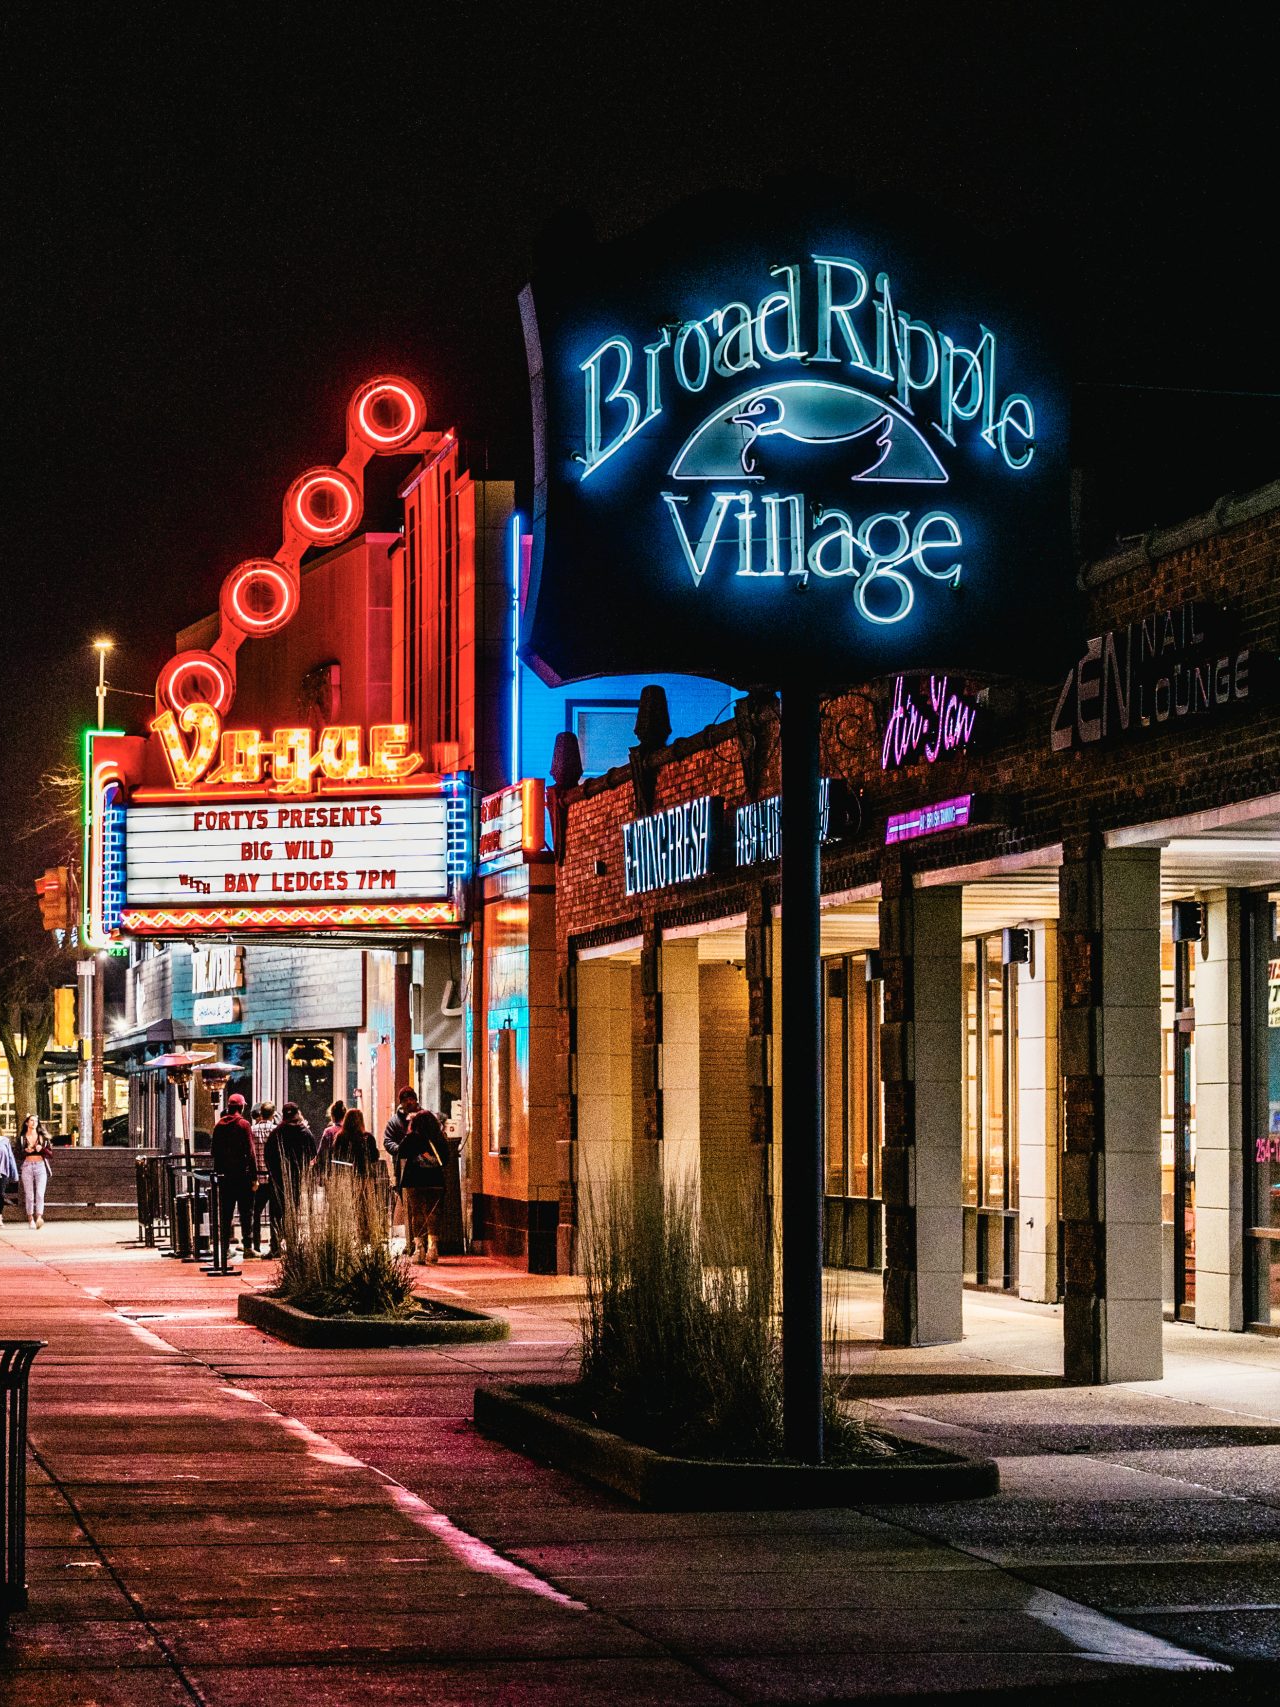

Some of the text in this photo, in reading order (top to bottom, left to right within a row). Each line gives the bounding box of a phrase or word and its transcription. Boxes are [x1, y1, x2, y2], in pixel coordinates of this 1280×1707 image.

[577, 254, 1036, 481] Broad Ripple
[660, 490, 963, 625] Village
[1141, 601, 1204, 662] NAIL
[1140, 650, 1249, 727] LOUNGE
[150, 702, 424, 794] Vogue
[241, 839, 334, 861] BIG WILD
[278, 805, 382, 829] PRESENTS
[179, 869, 397, 894] WITH BAY LEDGES 7PM
